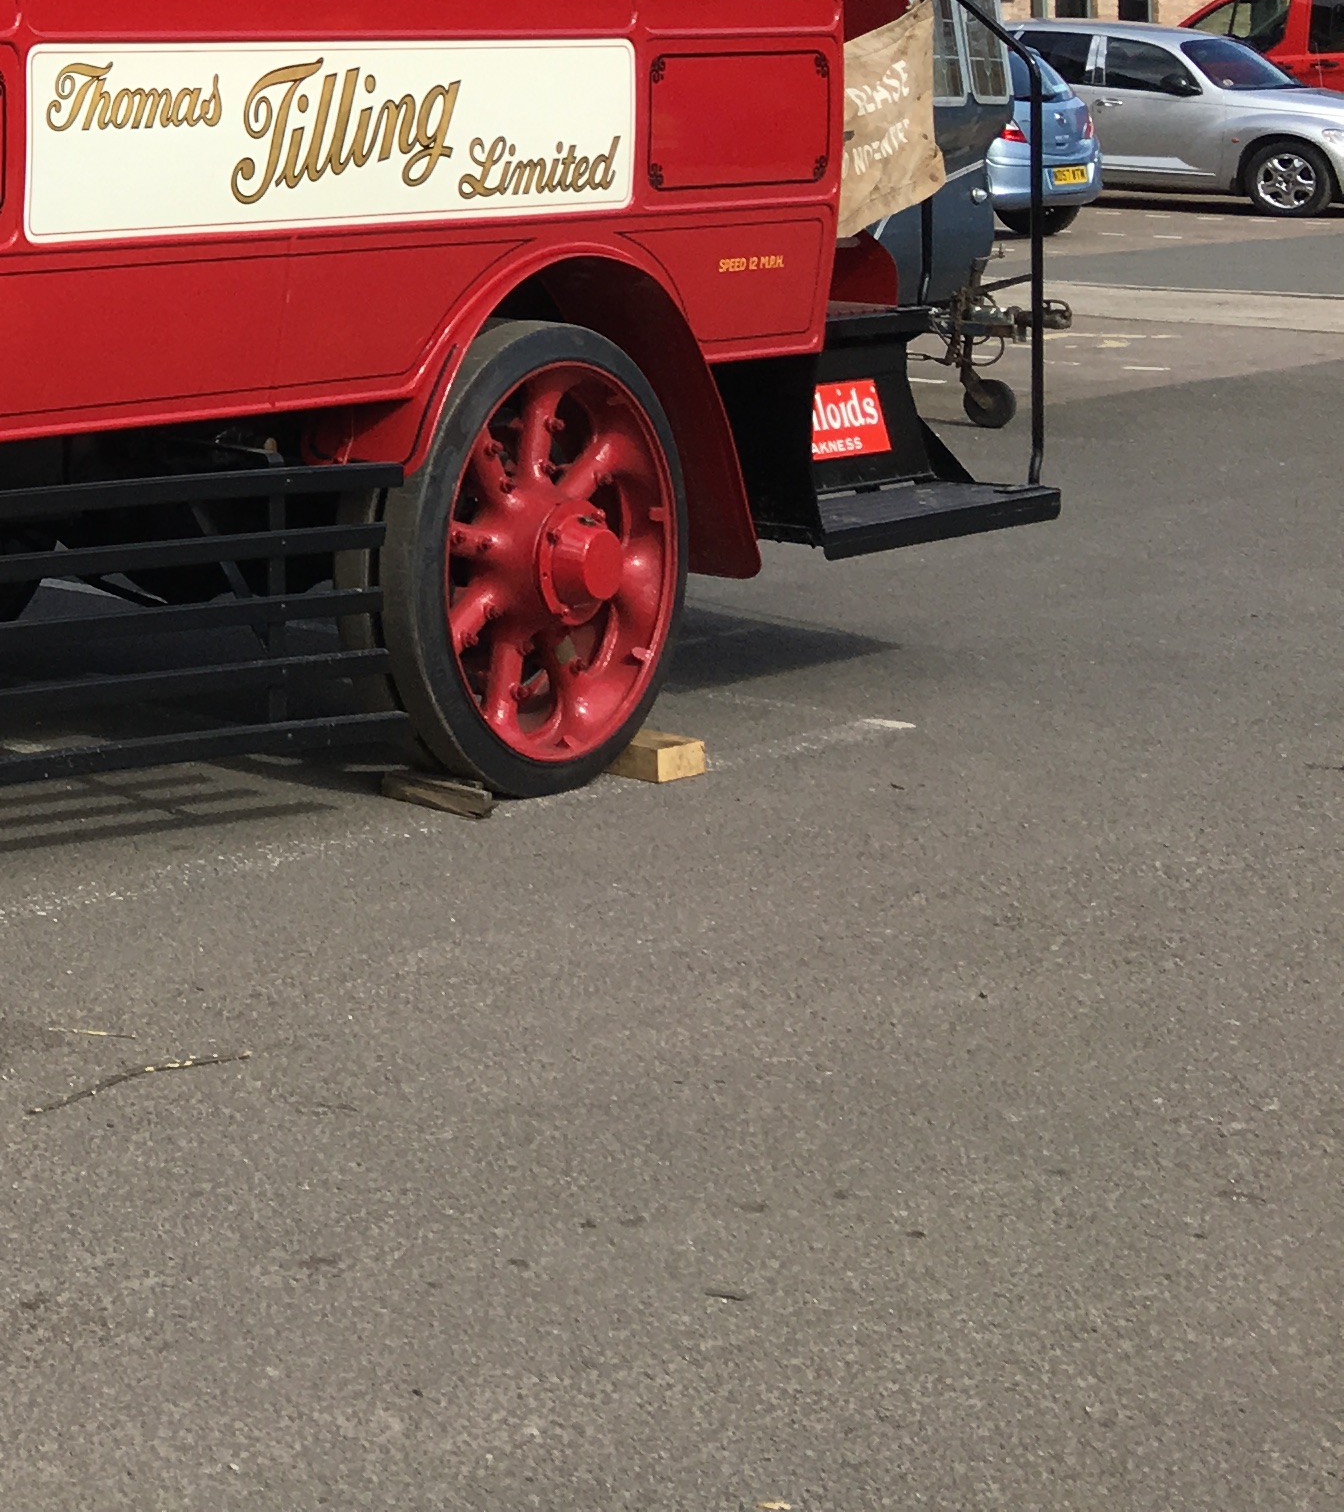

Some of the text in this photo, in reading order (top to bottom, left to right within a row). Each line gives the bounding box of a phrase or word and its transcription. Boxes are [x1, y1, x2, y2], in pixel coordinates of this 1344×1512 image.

[46, 56, 622, 206] Thomas Tilling Limited
[718, 257, 747, 272] SPEED
[748, 256, 759, 270] 12
